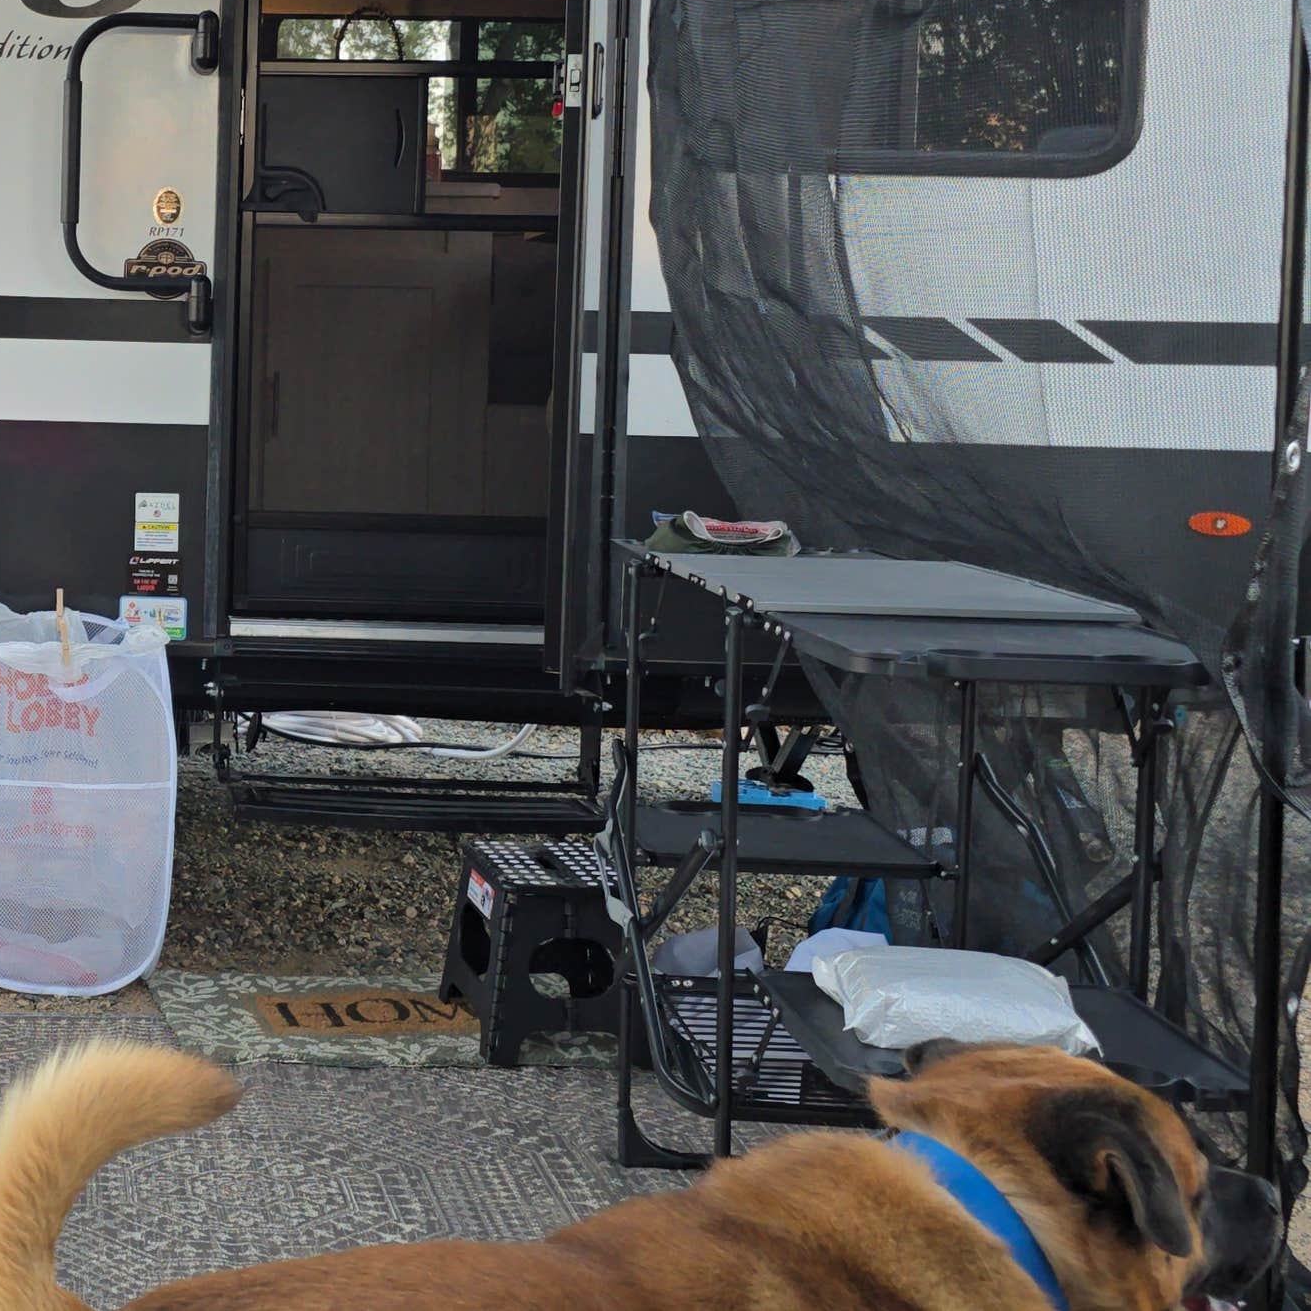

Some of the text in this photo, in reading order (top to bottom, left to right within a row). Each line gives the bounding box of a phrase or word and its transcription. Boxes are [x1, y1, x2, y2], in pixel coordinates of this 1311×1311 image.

[148, 226, 184, 238] RP171
[7, 699, 100, 737] LOBBY
[276, 997, 462, 1027] HOM
